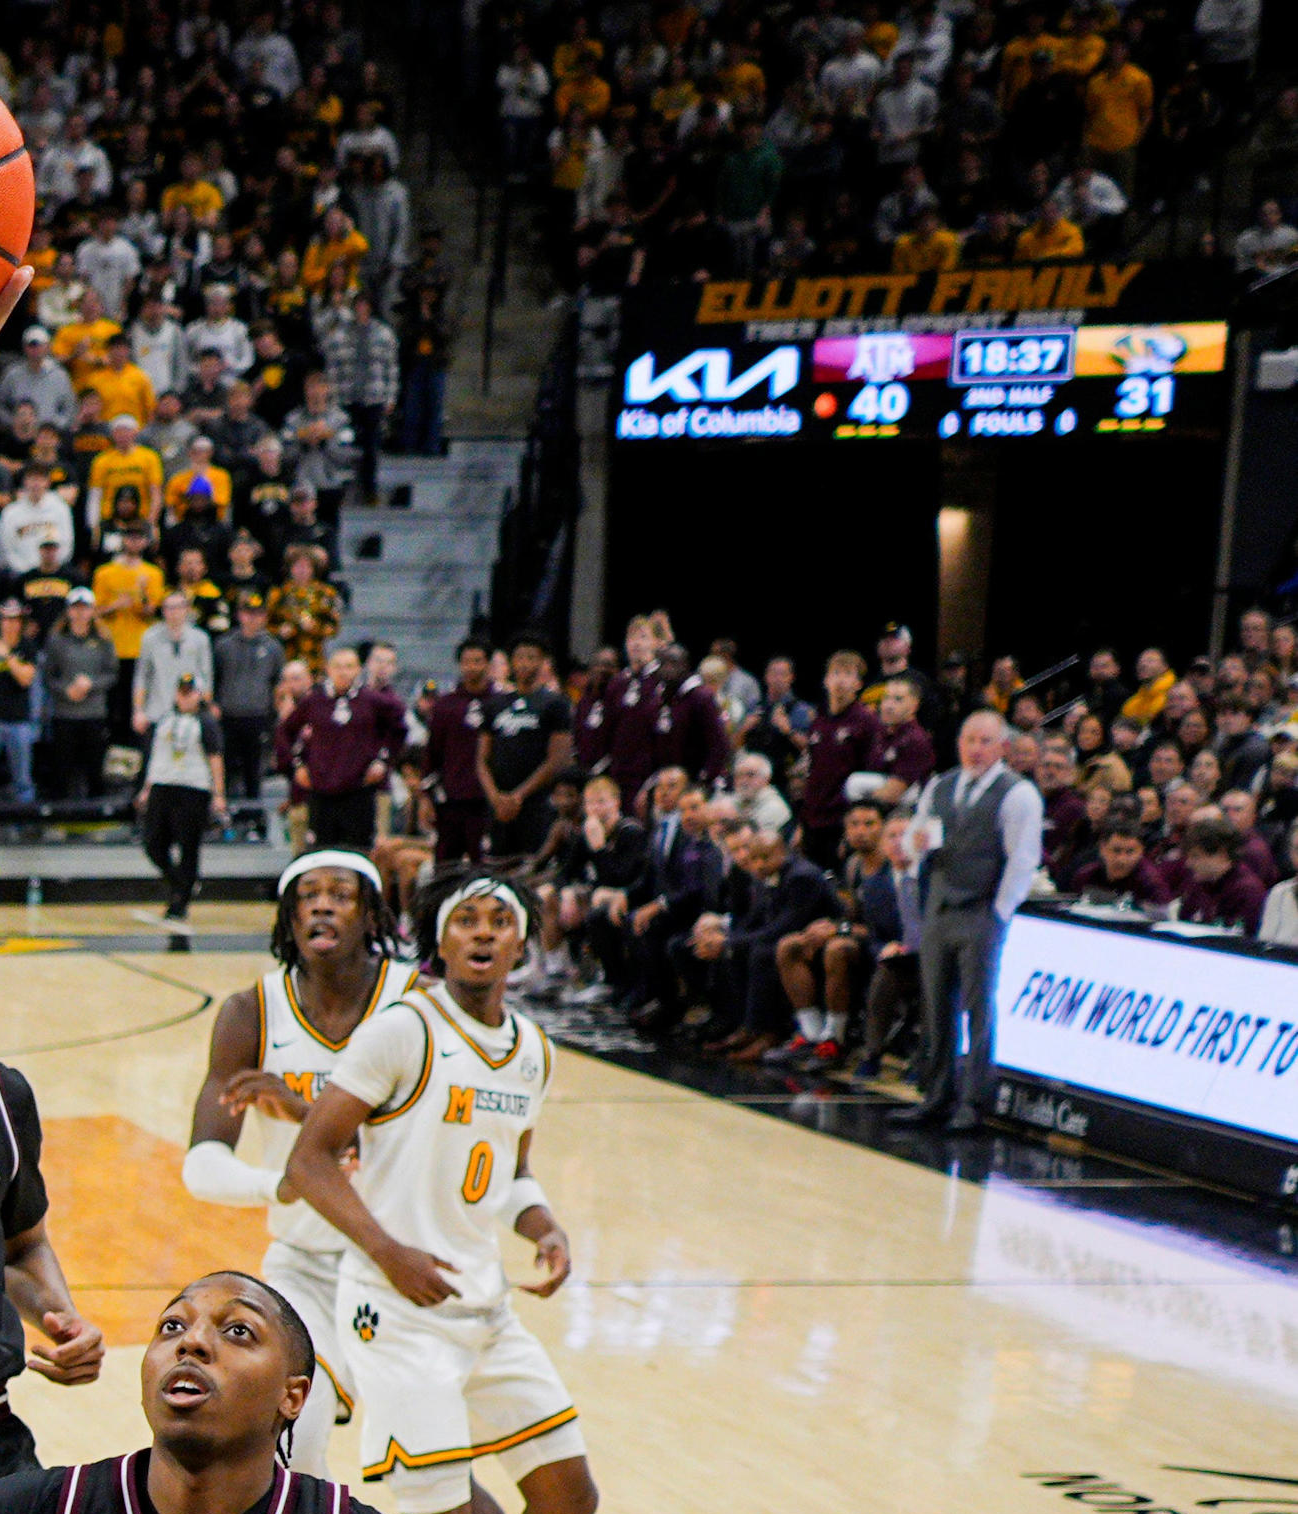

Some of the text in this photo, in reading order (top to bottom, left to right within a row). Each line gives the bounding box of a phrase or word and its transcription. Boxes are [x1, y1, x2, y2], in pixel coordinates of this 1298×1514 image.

[696, 262, 1144, 324] ELLIOTT FAMILY
[962, 338, 1066, 378] 18:37
[847, 381, 910, 424] 40
[1115, 375, 1174, 417] 31
[617, 404, 802, 439] Kia of Columbia
[970, 410, 1045, 437] FOULS
[1011, 970, 1095, 1028] FROM
[1084, 983, 1184, 1048] WORLD
[1174, 1004, 1272, 1067] FIRST
[461, 1141, 493, 1205] 0
